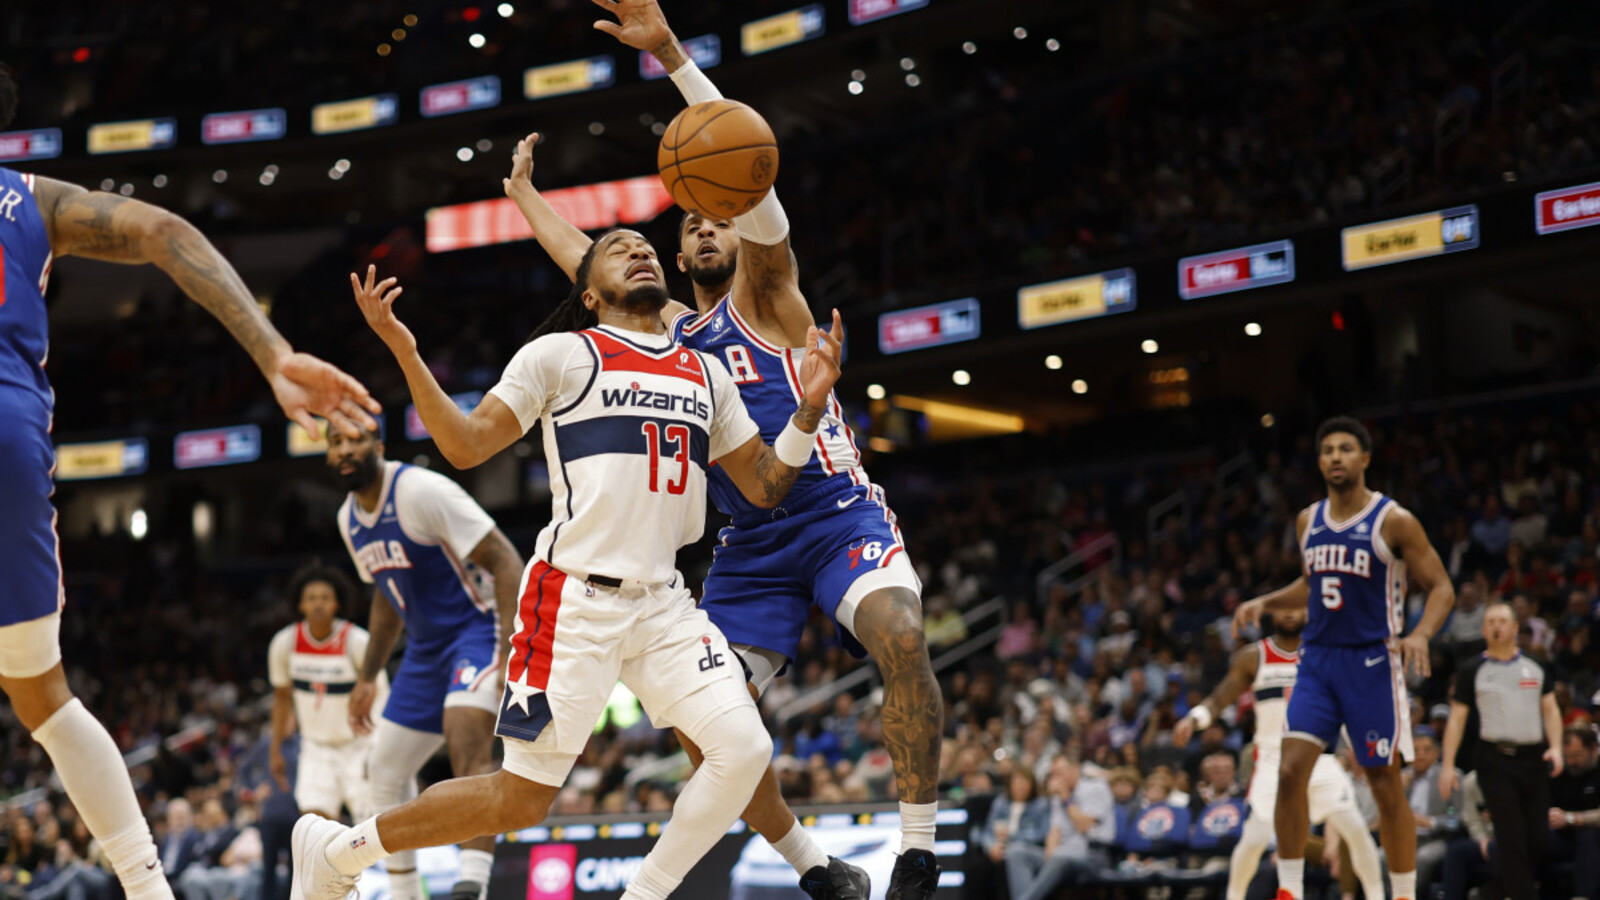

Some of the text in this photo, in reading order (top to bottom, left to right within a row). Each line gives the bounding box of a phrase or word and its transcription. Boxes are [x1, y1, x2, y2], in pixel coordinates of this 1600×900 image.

[602, 381, 709, 421] wizards
[641, 421, 691, 496] 13
[848, 540, 882, 571] 76
[1303, 544, 1372, 579] PHILA
[1320, 576, 1345, 611] 5
[698, 645, 726, 672] dc
[1366, 737, 1390, 758] 76
